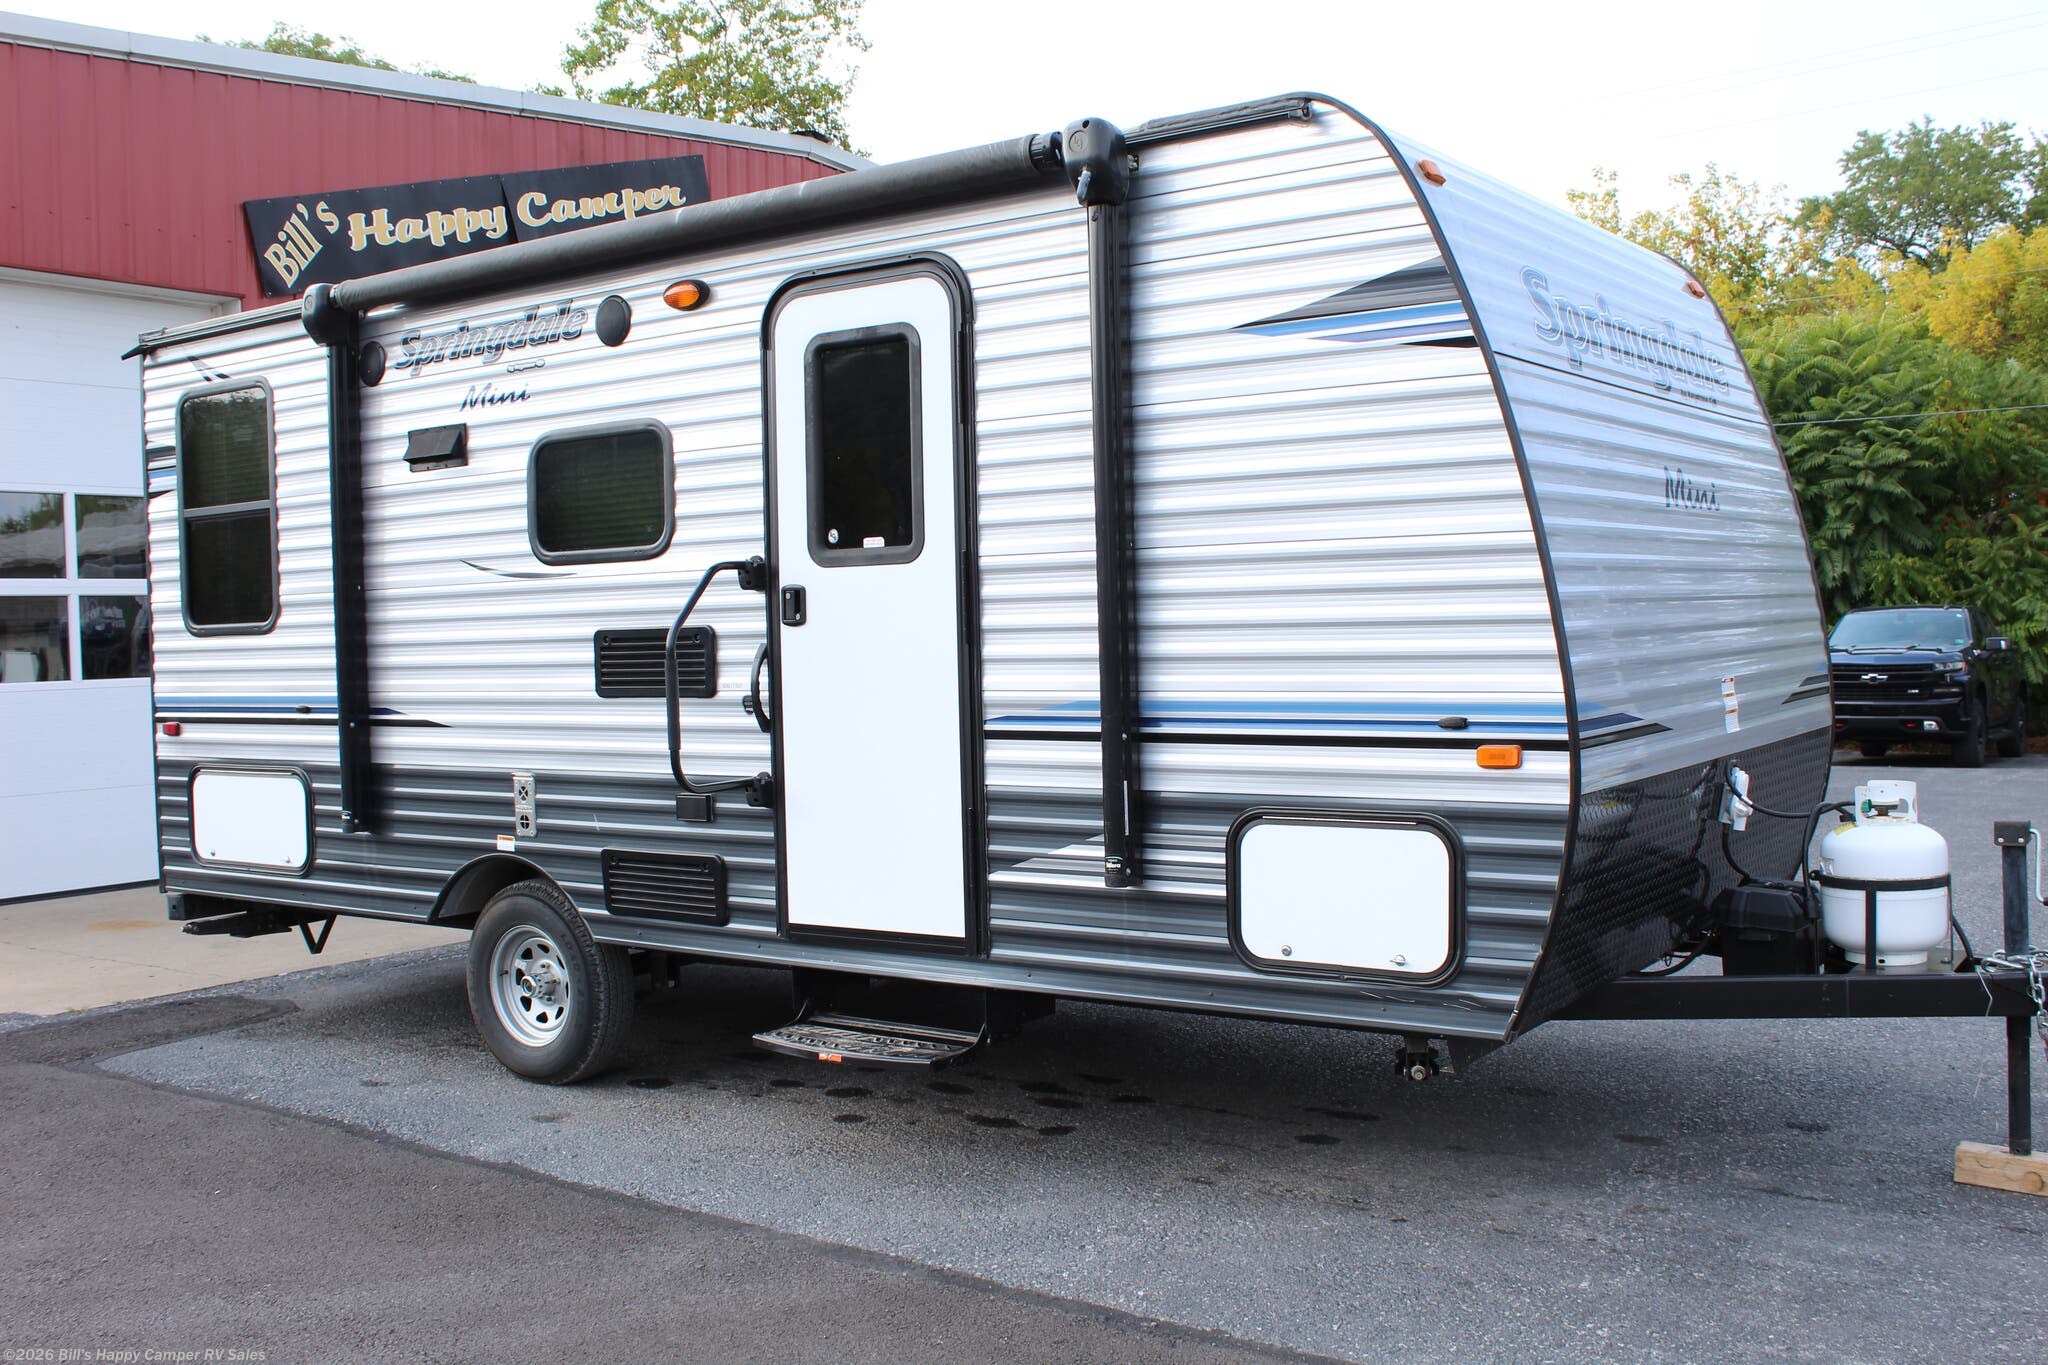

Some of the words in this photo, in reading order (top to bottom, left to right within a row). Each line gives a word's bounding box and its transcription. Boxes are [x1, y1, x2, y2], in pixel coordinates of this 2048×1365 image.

[263, 200, 340, 289] Bill's
[347, 206, 507, 252] Happy
[516, 184, 686, 220] Camper
[394, 299, 589, 377] Springdale
[1519, 265, 1730, 395] Springdale
[459, 382, 531, 412] Mini
[1663, 465, 1720, 511] Mini
